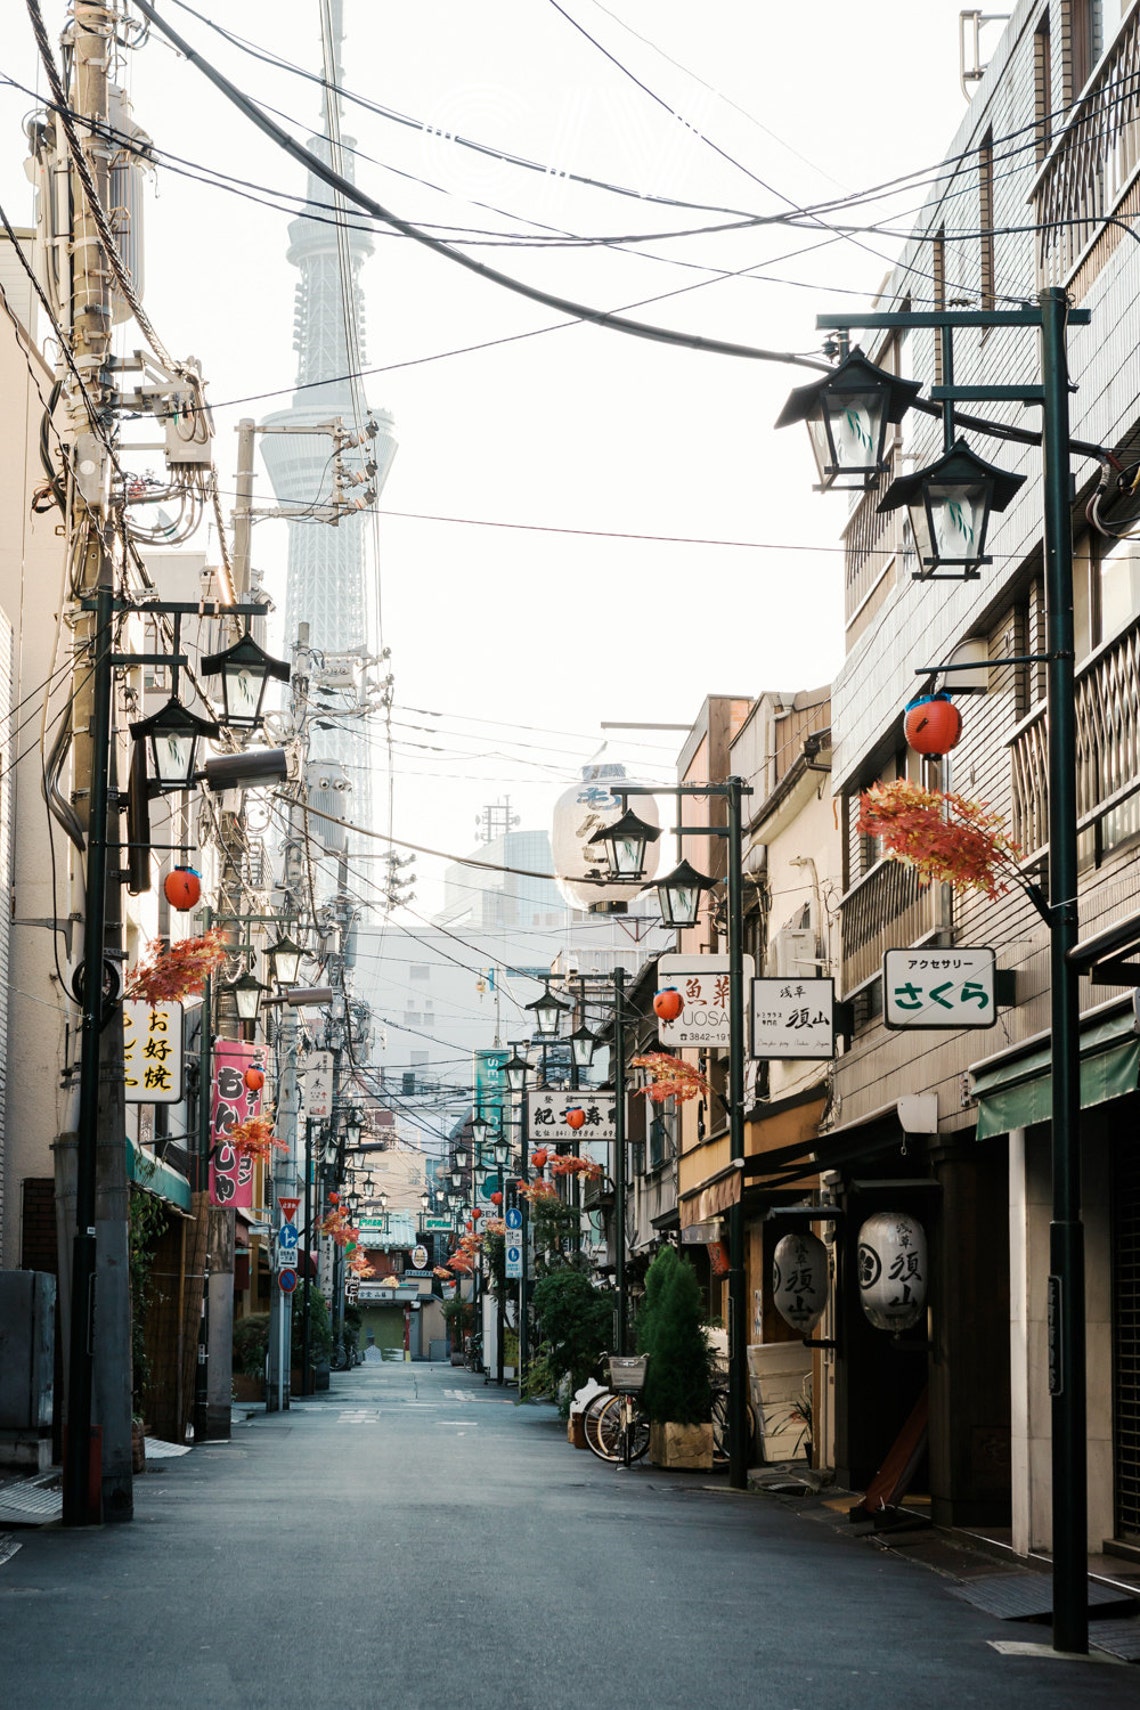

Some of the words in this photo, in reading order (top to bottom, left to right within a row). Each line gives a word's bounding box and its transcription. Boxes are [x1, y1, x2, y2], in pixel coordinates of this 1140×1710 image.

[908, 960, 973, 969] アクセサリー
[894, 981, 989, 1010] さくら
[785, 1007, 830, 1029] 須山
[143, 1011, 172, 1089] お好焼
[689, 1033, 730, 1041] 3842-191
[785, 1268, 816, 1313] 須山
[888, 1251, 922, 1307] 須山
